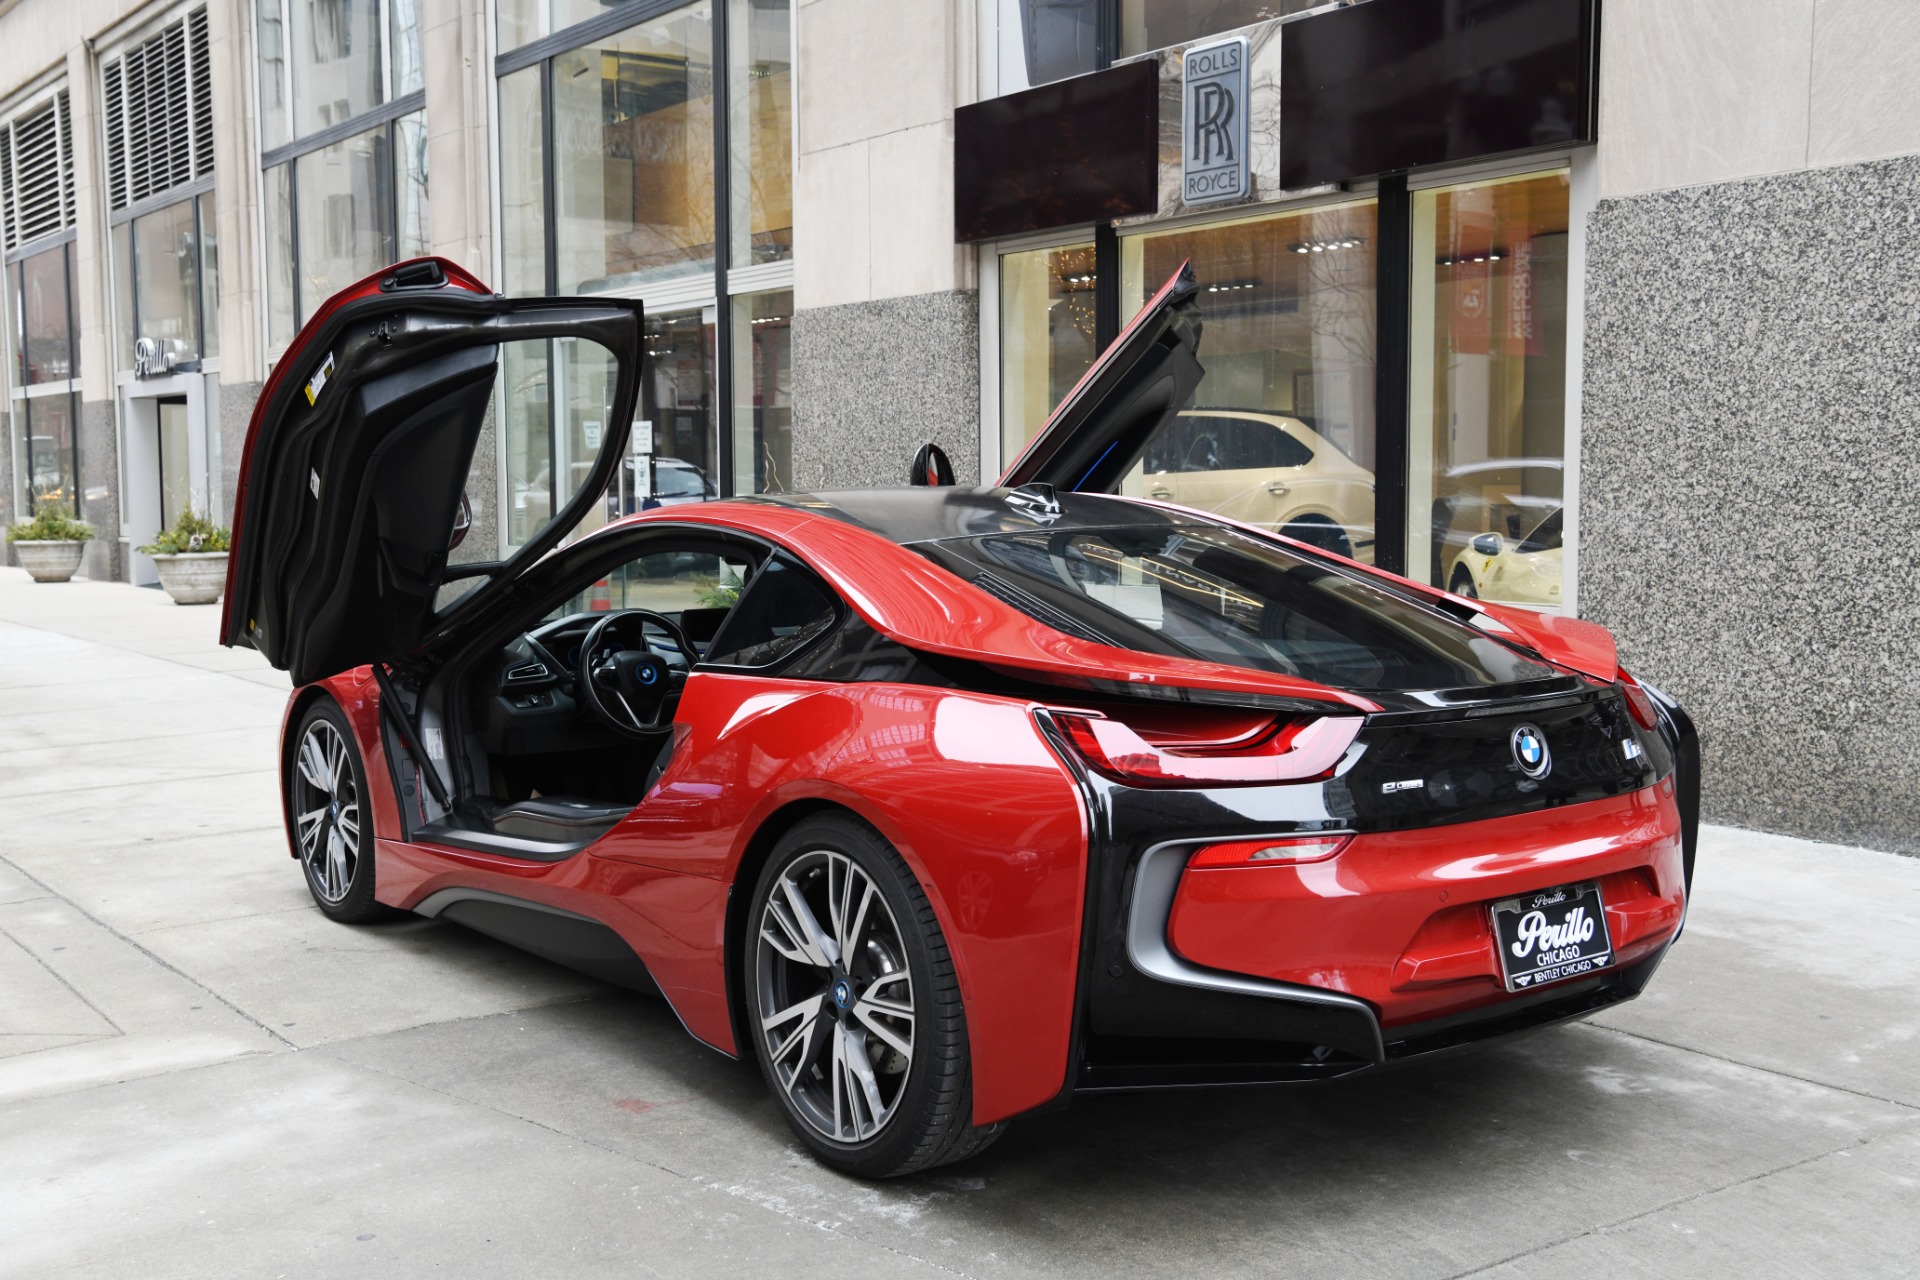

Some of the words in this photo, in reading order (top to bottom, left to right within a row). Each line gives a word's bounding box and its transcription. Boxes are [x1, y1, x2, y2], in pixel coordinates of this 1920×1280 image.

[1189, 48, 1238, 76] ROLLS
[1193, 81, 1234, 165] RR
[1188, 170, 1237, 195] ROYCE
[135, 338, 169, 377] Perillo
[1532, 892, 1566, 908] Perillo
[1511, 906, 1594, 958] Perillo
[1536, 945, 1580, 967] CHICAGO
[1534, 969, 1561, 982] BENTLEY
[1561, 961, 1591, 975] CHICAGO
